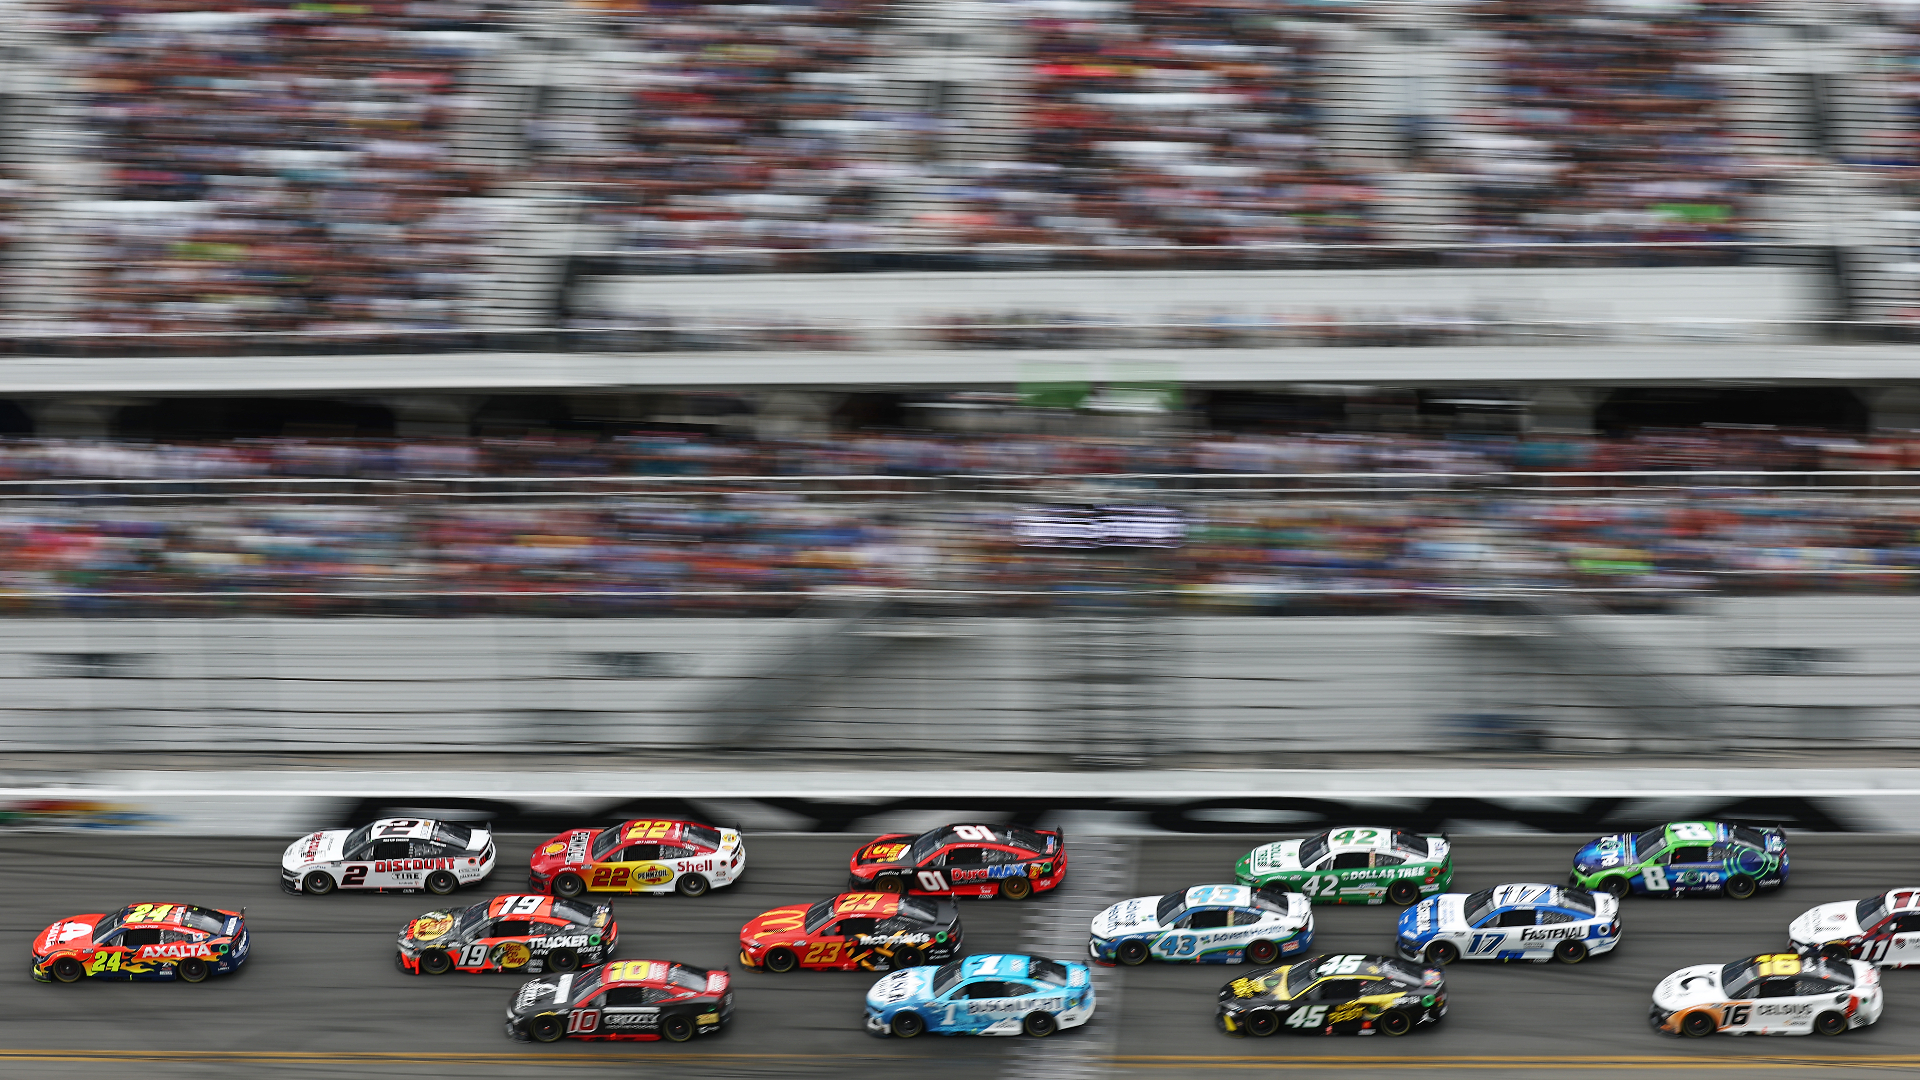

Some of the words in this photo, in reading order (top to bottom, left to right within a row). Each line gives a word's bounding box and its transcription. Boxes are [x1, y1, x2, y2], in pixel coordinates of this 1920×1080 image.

[379, 821, 420, 836] 2
[626, 821, 672, 839] 22
[952, 825, 998, 841] 01
[1332, 829, 1378, 845] 42
[1669, 822, 1715, 840] 8
[375, 857, 455, 873] DISCOUNT
[637, 869, 669, 879] PENNZOIL
[677, 859, 713, 873] Shell
[1350, 868, 1396, 881] DOLLAR
[1397, 866, 1426, 879] TREE
[341, 866, 369, 885] 2
[592, 868, 630, 887] 22
[917, 871, 950, 892] 01
[1642, 866, 1670, 891] 8
[1302, 874, 1339, 897] 42
[1500, 886, 1550, 904] 17
[837, 893, 885, 912] 23
[1189, 887, 1240, 904] 43
[125, 904, 174, 923] 24
[497, 895, 545, 916] 19
[142, 943, 212, 959] AXALTA
[528, 935, 589, 949] TRACKER
[577, 945, 603, 954] BOATS
[1159, 935, 1198, 956] 43
[1463, 931, 1508, 956] 17
[1858, 940, 1891, 961] 11
[91, 950, 121, 972] 24
[458, 944, 488, 967] 19
[802, 941, 844, 964] 23
[609, 961, 651, 982] 10
[973, 956, 1003, 975] 1
[1316, 954, 1367, 975] 45
[1754, 953, 1801, 977] 16
[567, 1009, 601, 1034] 10
[940, 1003, 957, 1026] 1
[1284, 1005, 1331, 1029] 45
[1719, 1005, 1752, 1028] 16
